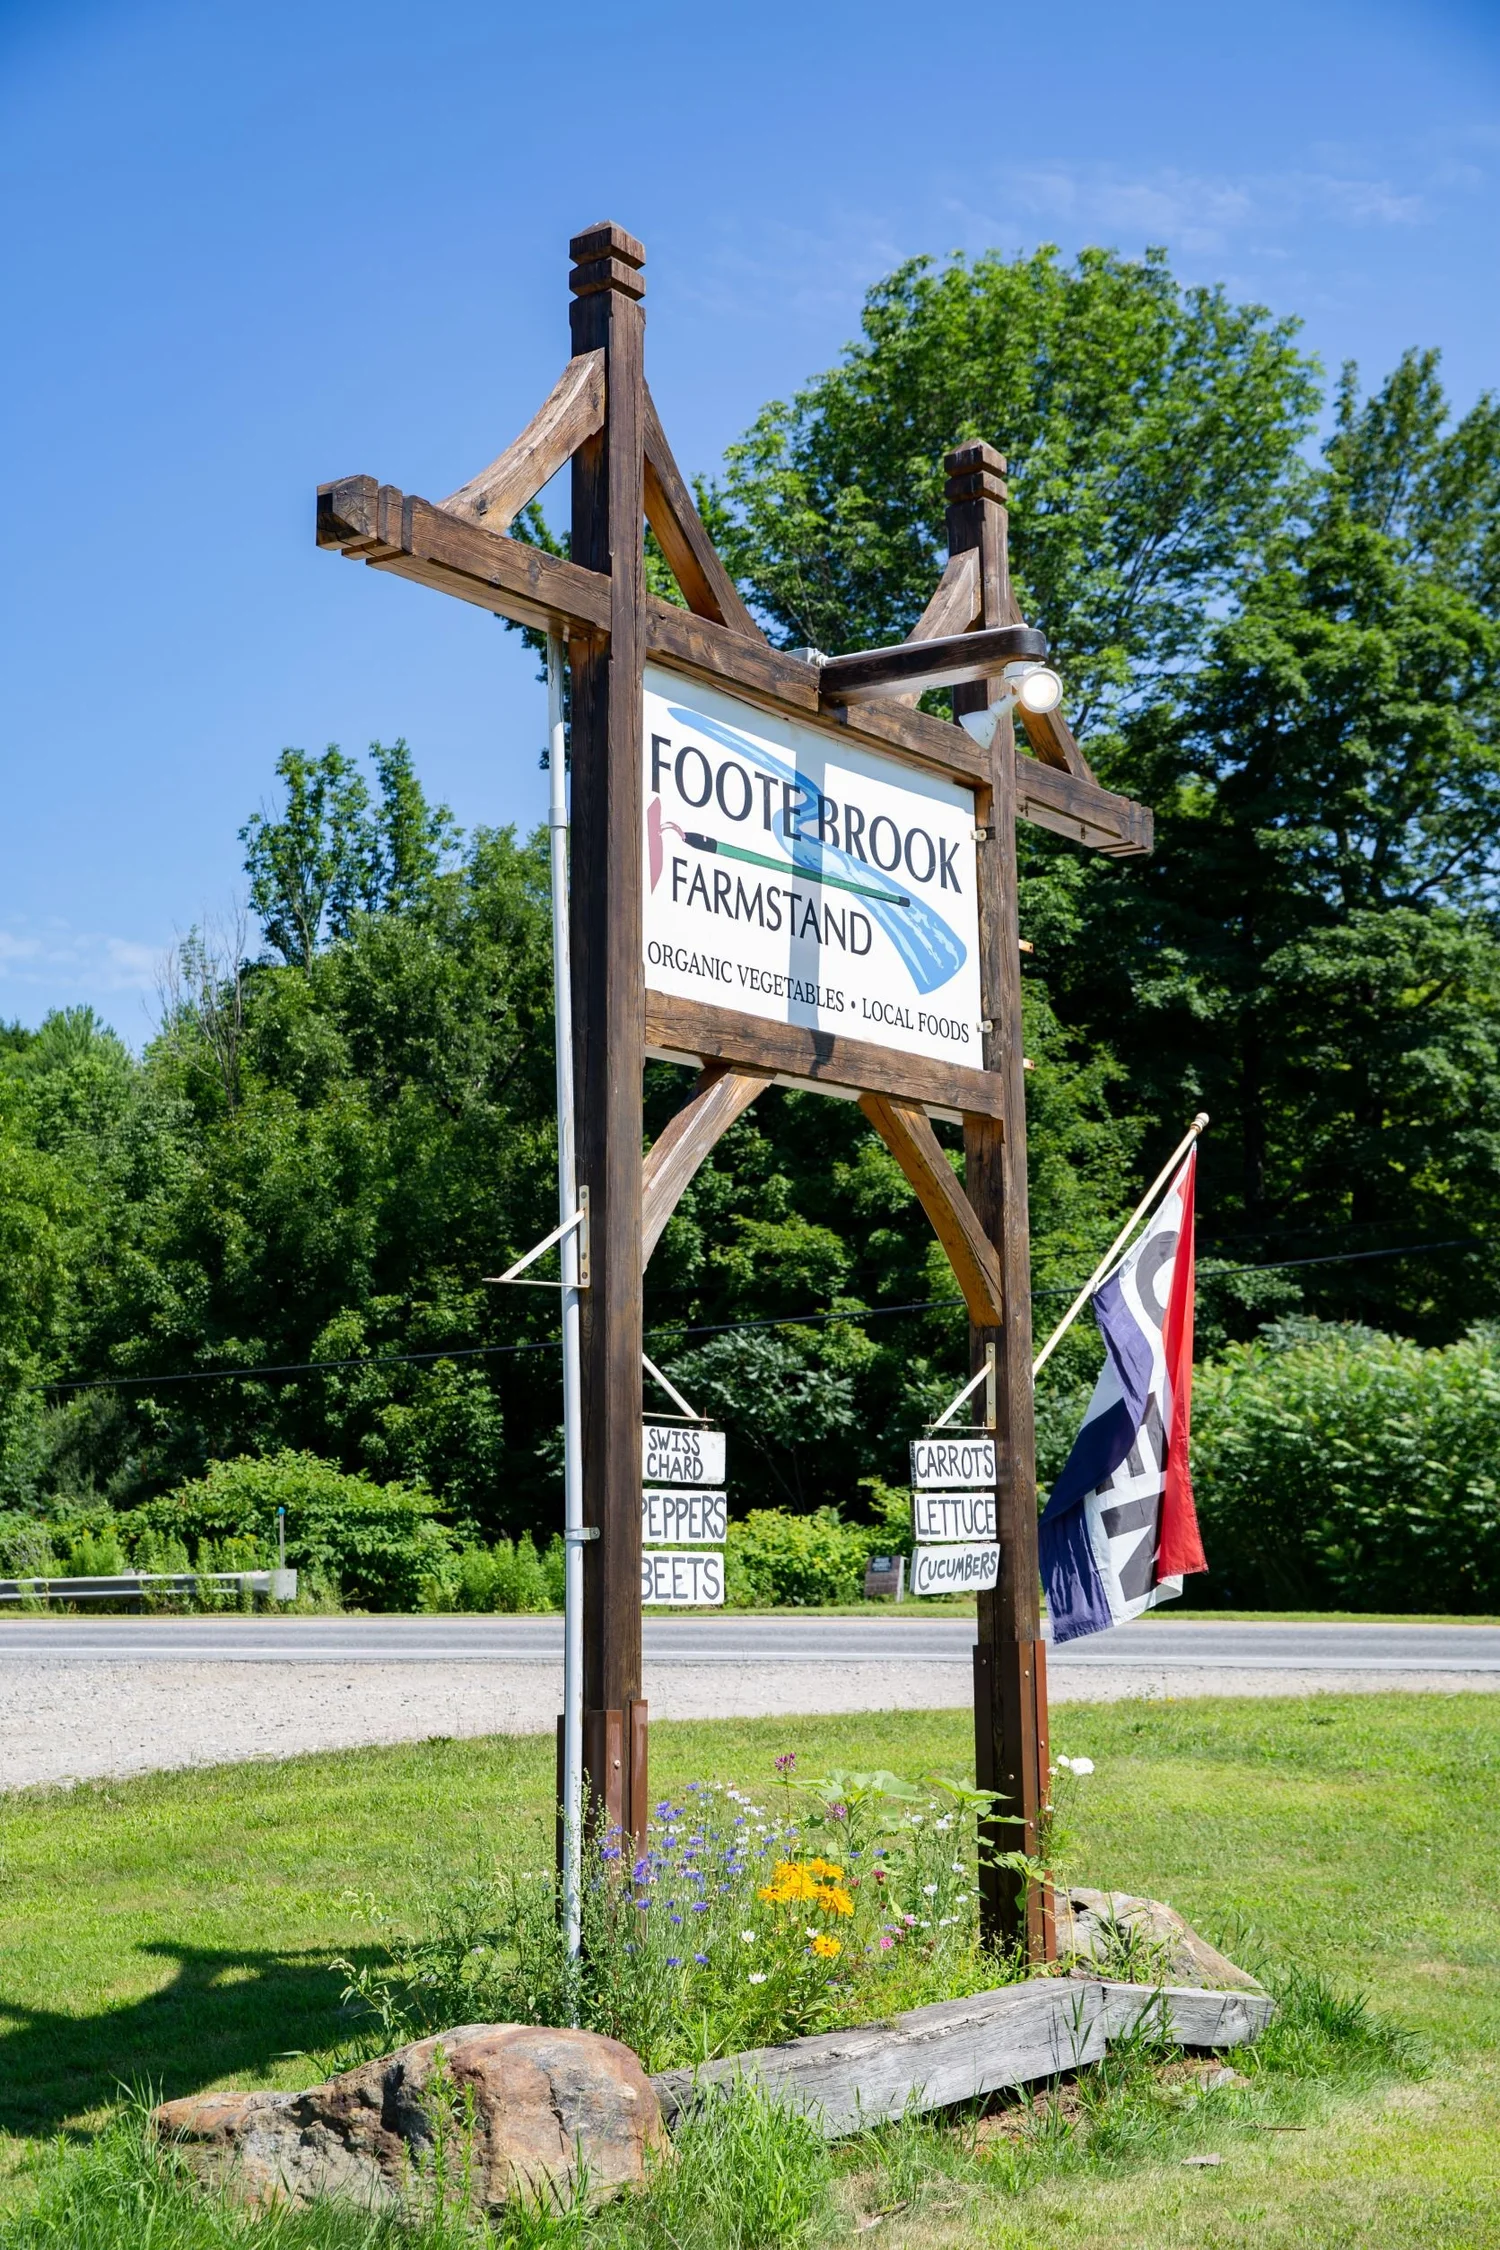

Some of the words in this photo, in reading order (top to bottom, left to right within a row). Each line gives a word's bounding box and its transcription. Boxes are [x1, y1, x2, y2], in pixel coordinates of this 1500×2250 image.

[651, 733, 802, 842] FOOTE
[818, 795, 963, 894] BROOK
[672, 856, 872, 956] FARMSTAND
[648, 941, 732, 984] ORGANIC
[737, 966, 845, 1013] VEGETABLES
[862, 998, 914, 1031] LOCAL
[918, 1012, 970, 1044] FOODS
[648, 1428, 700, 1457] SWISS
[916, 1445, 994, 1479] CARROTS
[646, 1453, 704, 1481] CHARD
[916, 1499, 996, 1537] LETTUCE
[918, 1551, 998, 1591] CUCUMBERS
